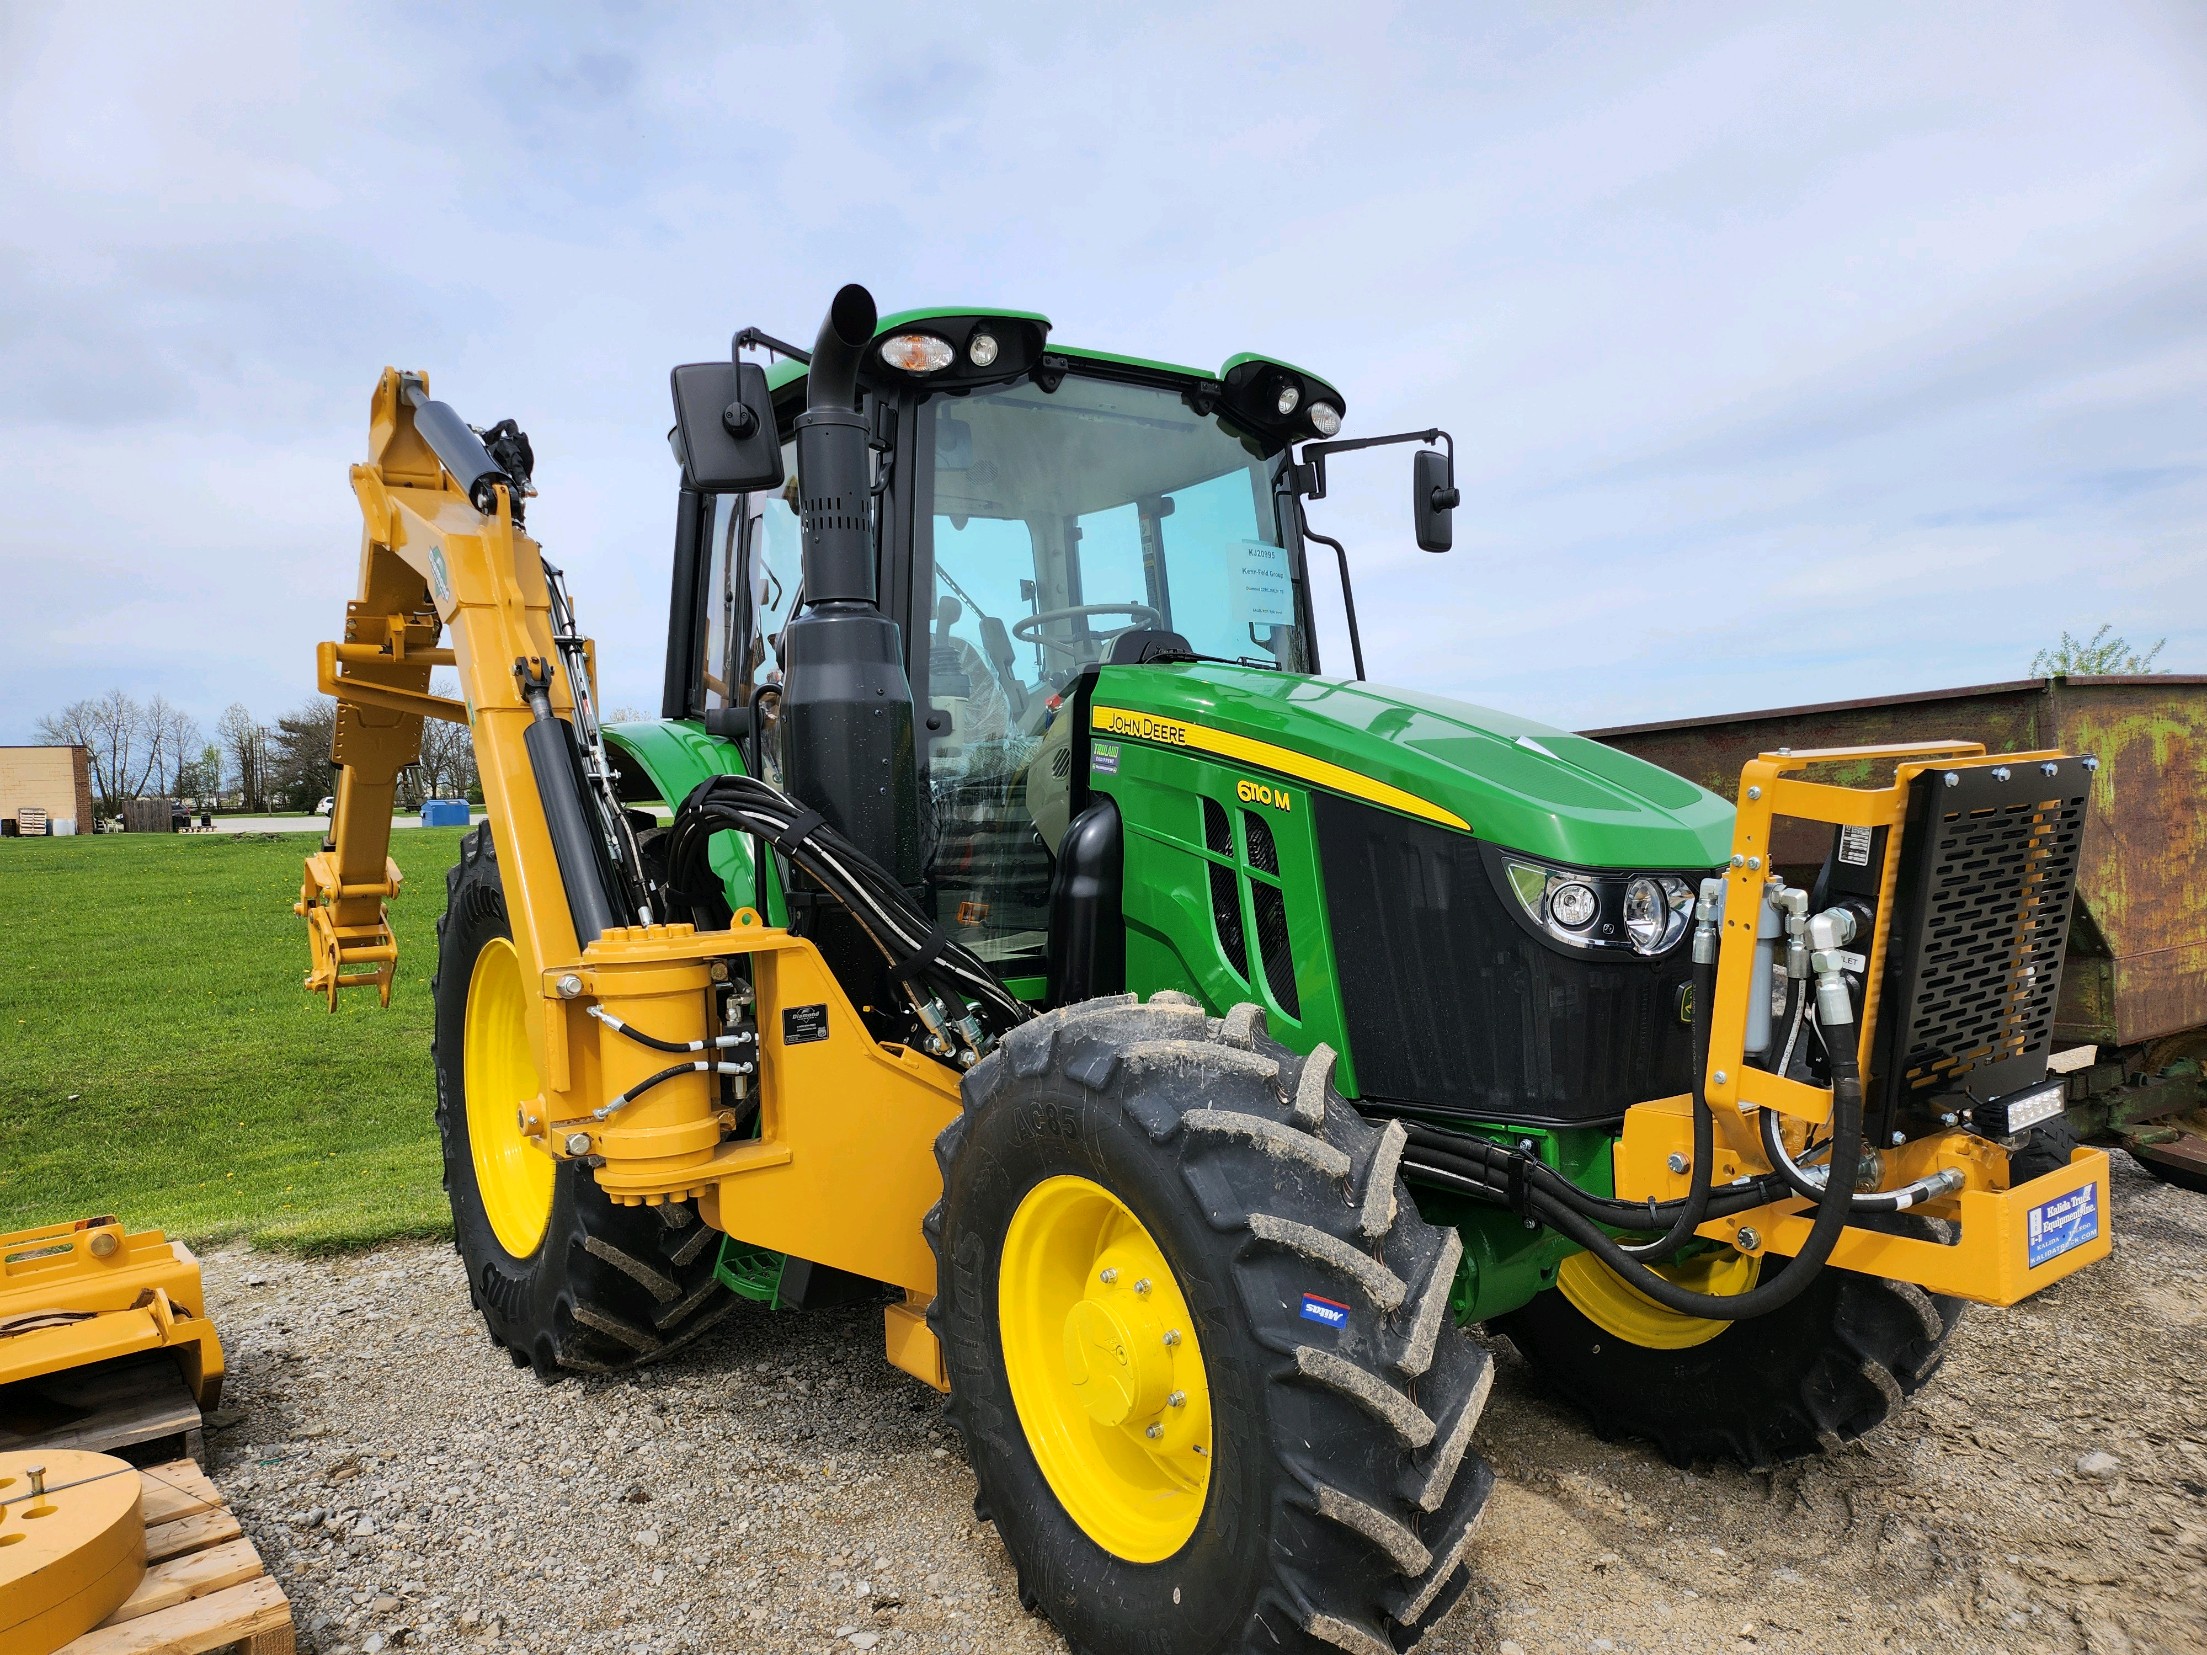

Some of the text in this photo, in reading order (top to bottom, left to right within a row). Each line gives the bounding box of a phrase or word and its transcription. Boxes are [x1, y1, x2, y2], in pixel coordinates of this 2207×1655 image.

[1109, 712, 1186, 743] JOHN DEERE
[1013, 1102, 1079, 1142] AC85
[2047, 1194, 2092, 1218] Kalida Truck
[2037, 1237, 2060, 1251] KALIDA
